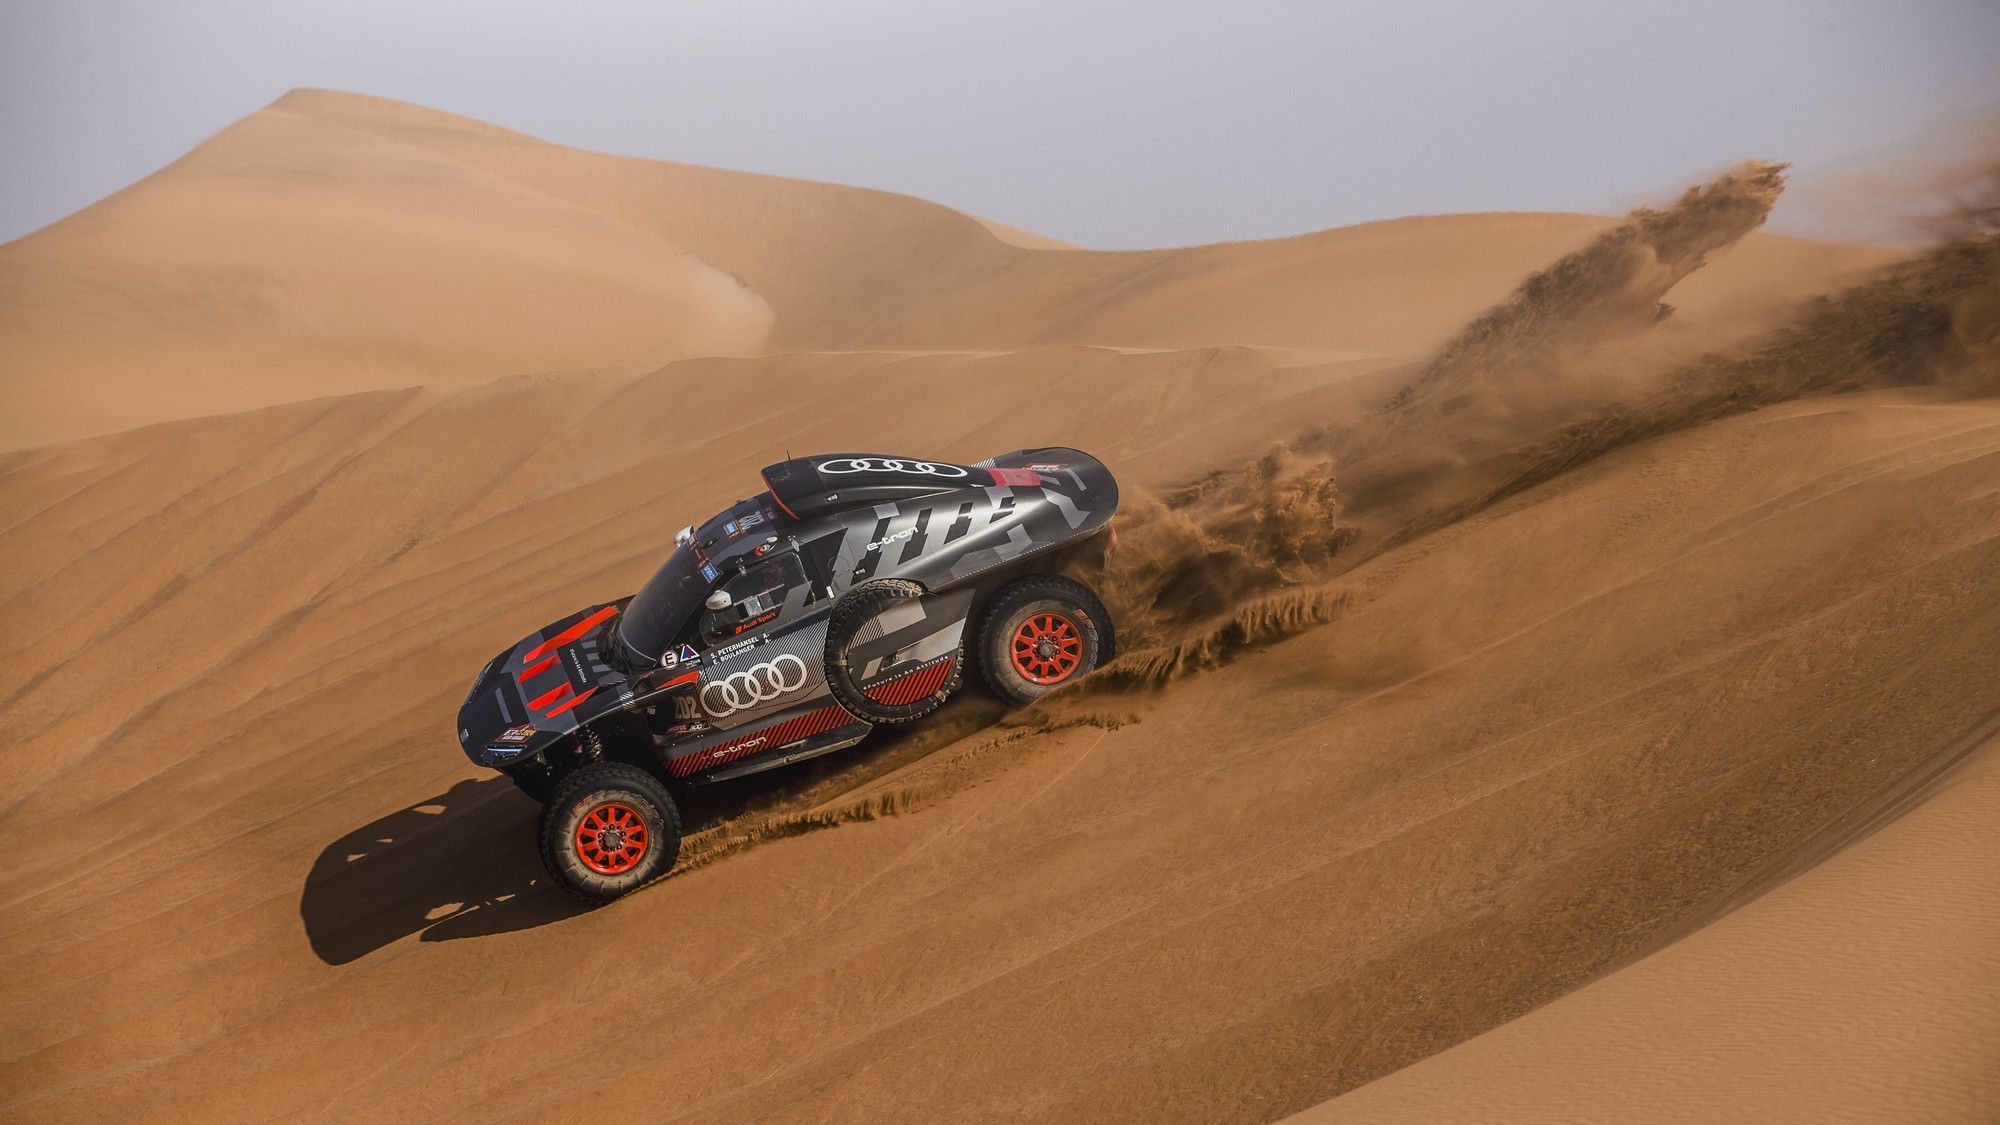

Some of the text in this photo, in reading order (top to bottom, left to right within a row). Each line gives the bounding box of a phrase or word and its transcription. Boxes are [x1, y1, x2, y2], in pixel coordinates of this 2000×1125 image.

[866, 526, 919, 551] e-tron
[743, 612, 776, 630] Audi Sport
[717, 636, 760, 656] PETERHANSEL
[720, 644, 755, 662] BOULANGER
[916, 655, 949, 670] Attitude
[713, 736, 767, 758] e-tron
